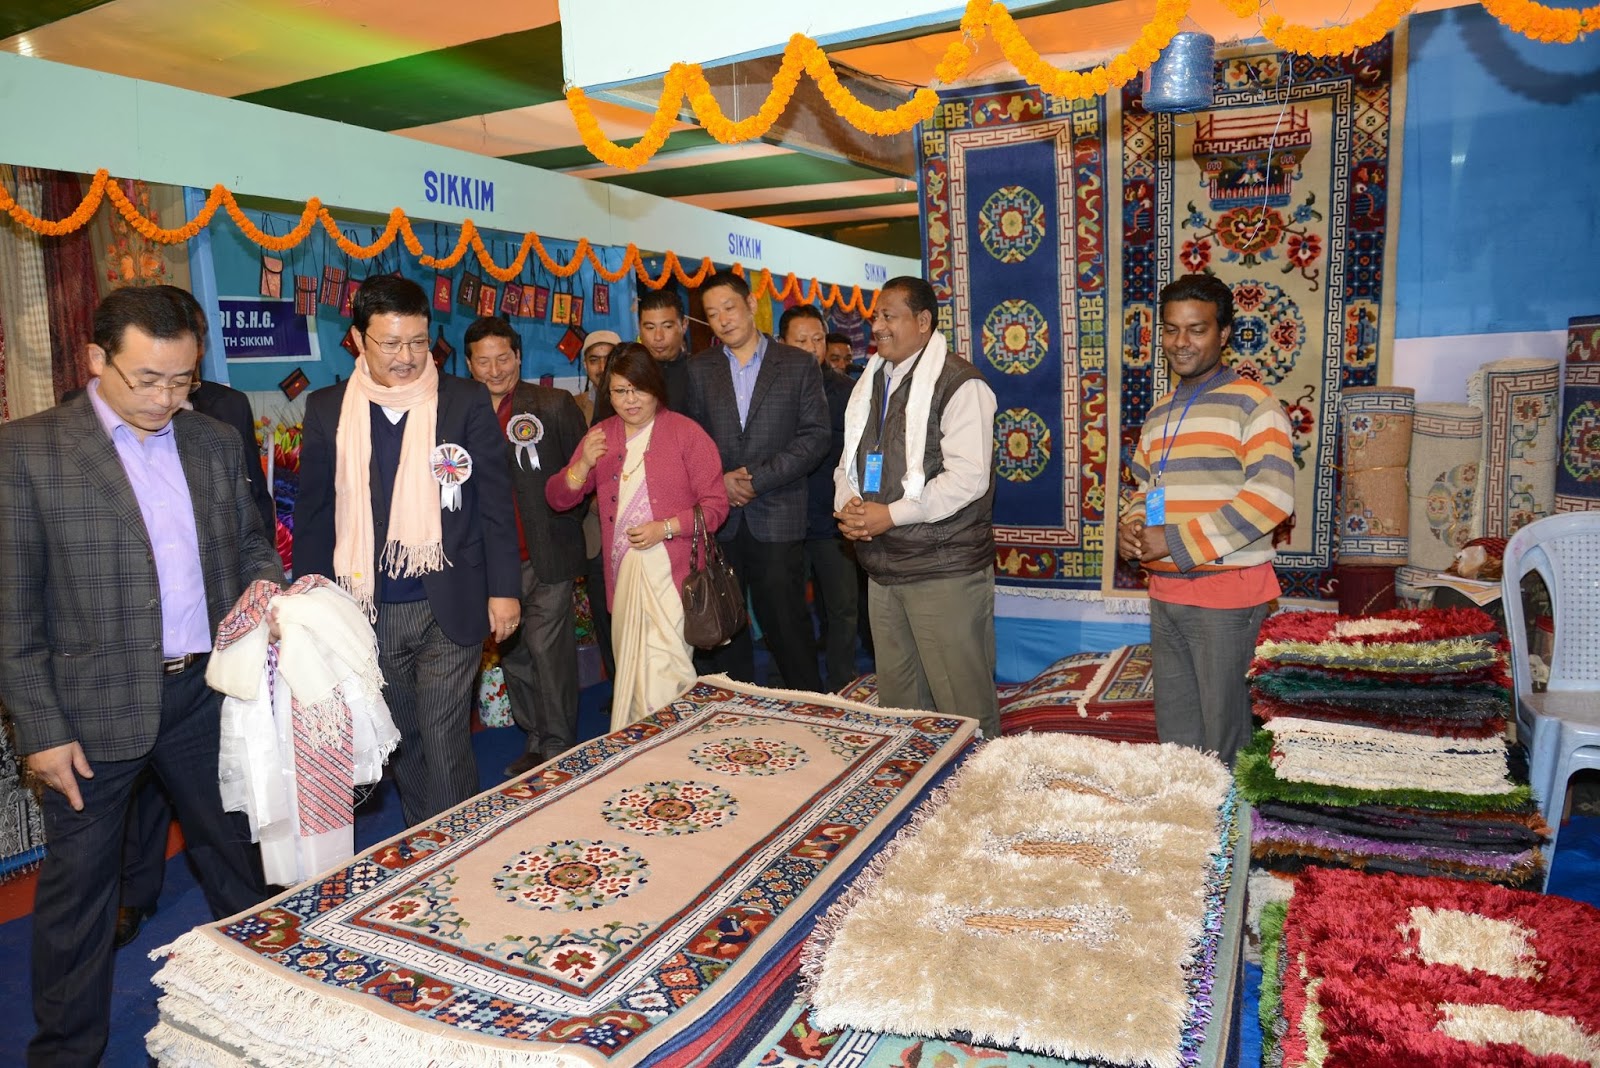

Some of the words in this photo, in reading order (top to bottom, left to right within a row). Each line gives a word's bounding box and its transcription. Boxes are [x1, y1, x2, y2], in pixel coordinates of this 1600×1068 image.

[424, 170, 494, 212] SIKKIM
[728, 232, 762, 260] SIKKIM
[864, 263, 888, 282] SIKKIM
[235, 310, 275, 329] S.H.G.
[224, 336, 238, 347] TH
[240, 336, 274, 347] SIKKIM
